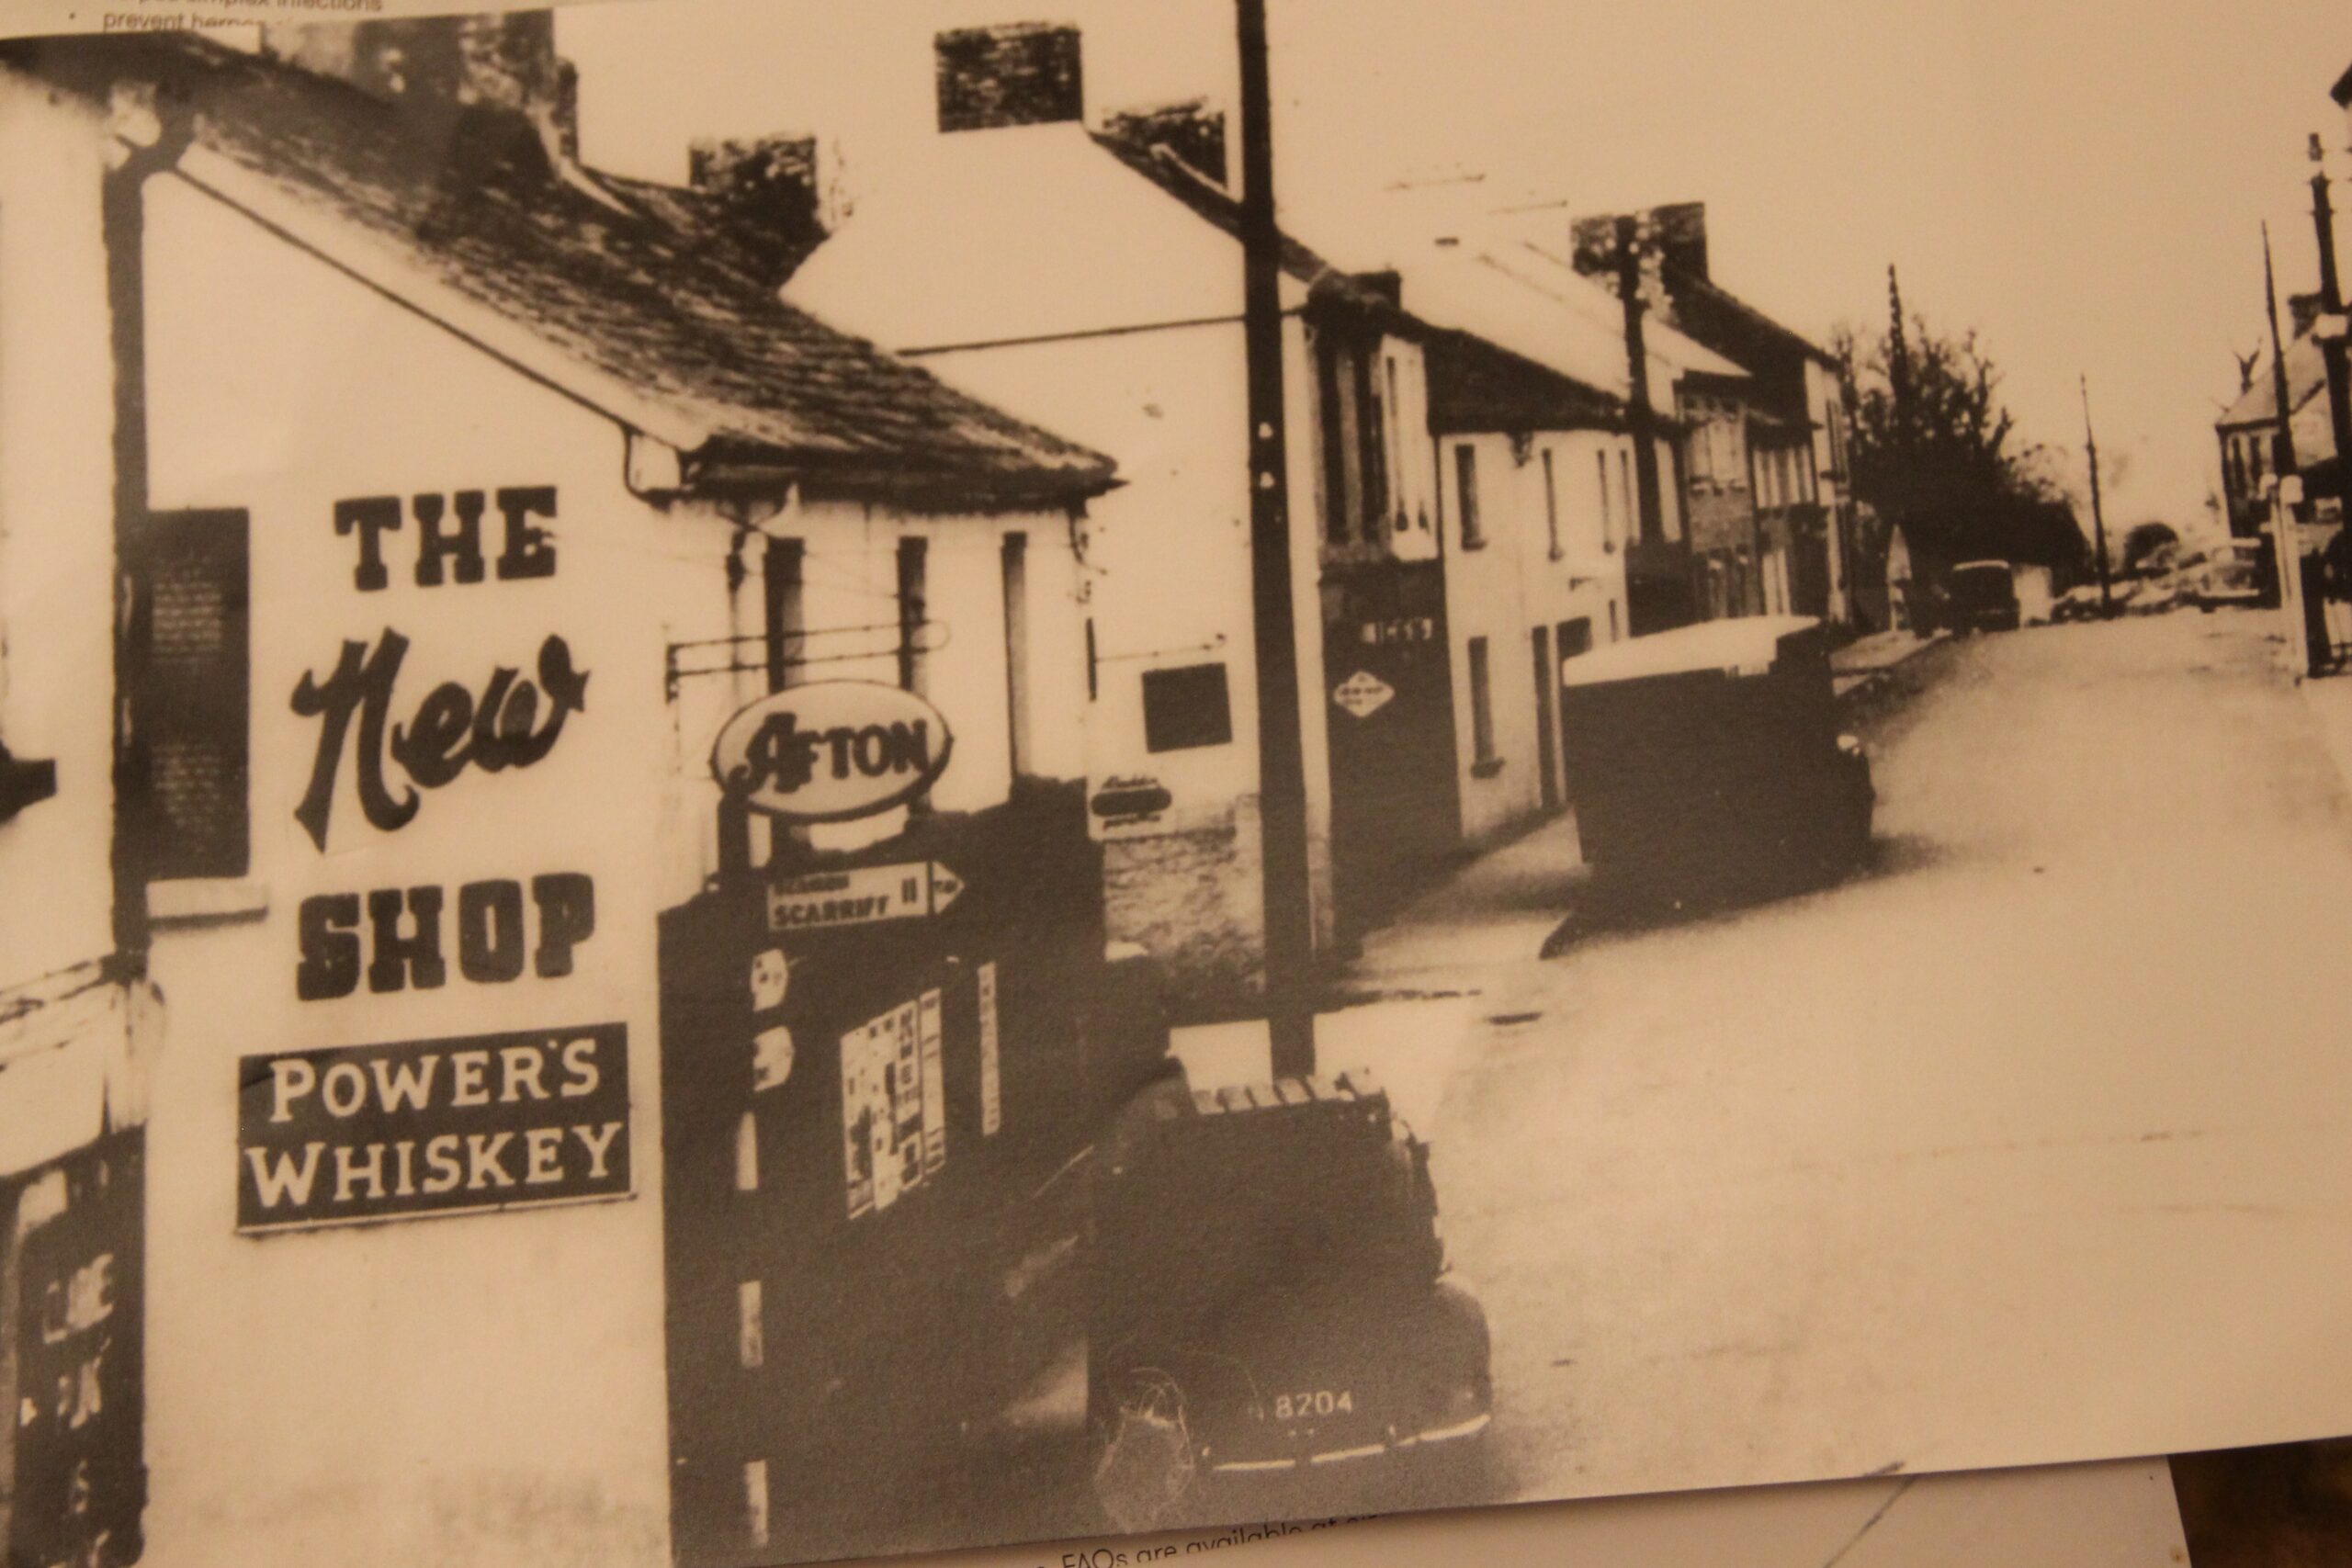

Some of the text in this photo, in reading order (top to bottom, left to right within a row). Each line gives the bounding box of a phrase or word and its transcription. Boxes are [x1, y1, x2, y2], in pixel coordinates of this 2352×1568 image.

[103, 12, 184, 32] prevent
[334, 485, 558, 592] THE
[290, 626, 591, 855] New
[740, 711, 930, 793] AFTON
[297, 873, 595, 1001] SHOP
[775, 895, 889, 927] SCARRIFF
[268, 1038, 600, 1122] POWER'S
[244, 1122, 623, 1209] WHISKEY
[1275, 1390, 1352, 1418] 8204
[1062, 1549, 1128, 1568] FAQs
[1136, 1545, 1177, 1563] are
